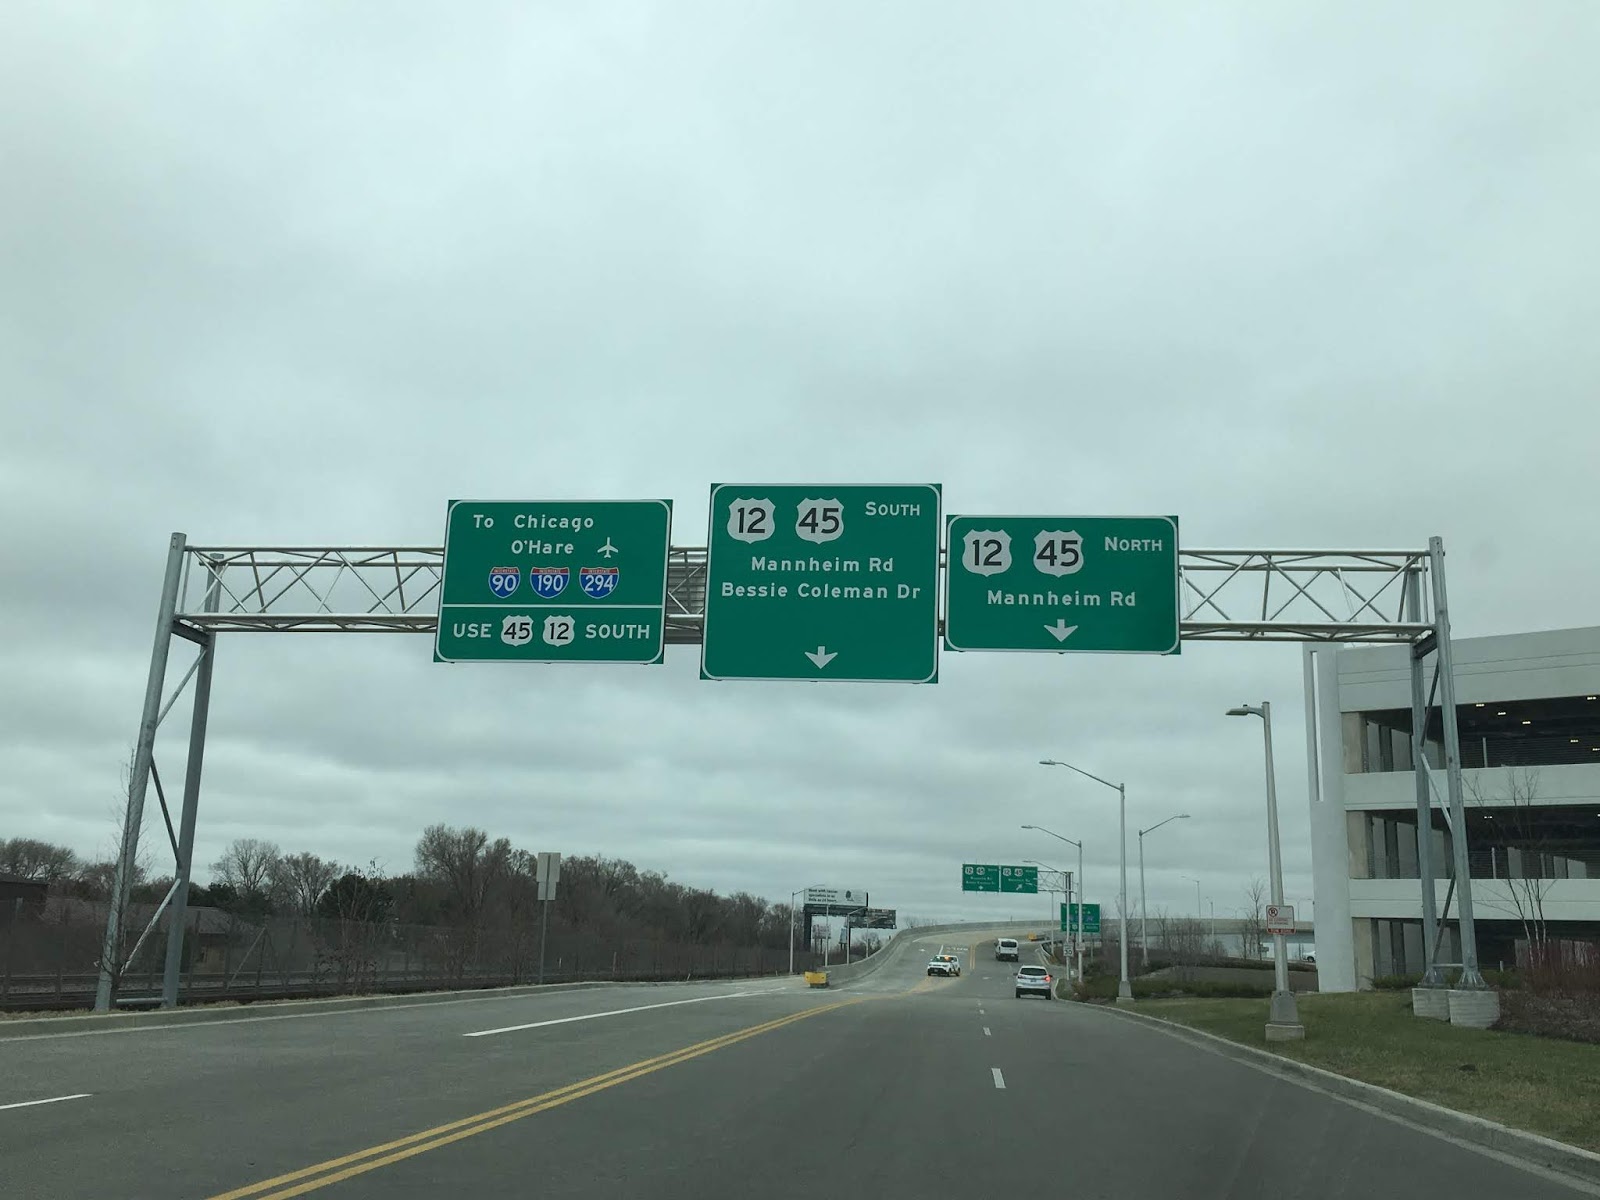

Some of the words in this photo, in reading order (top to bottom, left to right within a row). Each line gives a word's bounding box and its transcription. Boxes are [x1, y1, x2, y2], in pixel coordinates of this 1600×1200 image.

[473, 514, 495, 529] To
[514, 514, 594, 532] Chicago
[737, 507, 766, 534] 12
[798, 507, 840, 534] 45
[865, 501, 921, 516] SOUTH
[511, 540, 574, 554] O'Hare
[972, 539, 1003, 566] 12
[1036, 540, 1080, 567] 45
[1104, 536, 1162, 551] NORTH
[751, 556, 860, 572] Mannheim
[869, 557, 894, 572] Rd
[492, 575, 517, 592] 90
[537, 575, 563, 591] 190
[584, 575, 614, 591] 294
[721, 582, 788, 597] Bessie
[797, 583, 888, 599] Coleman
[897, 584, 921, 599] Dr
[987, 590, 1100, 606] Mannheim
[1110, 591, 1136, 607] Rd
[453, 623, 492, 638] USE
[503, 622, 530, 640] 45
[549, 622, 569, 640] 12
[585, 624, 650, 639] SOUTH
